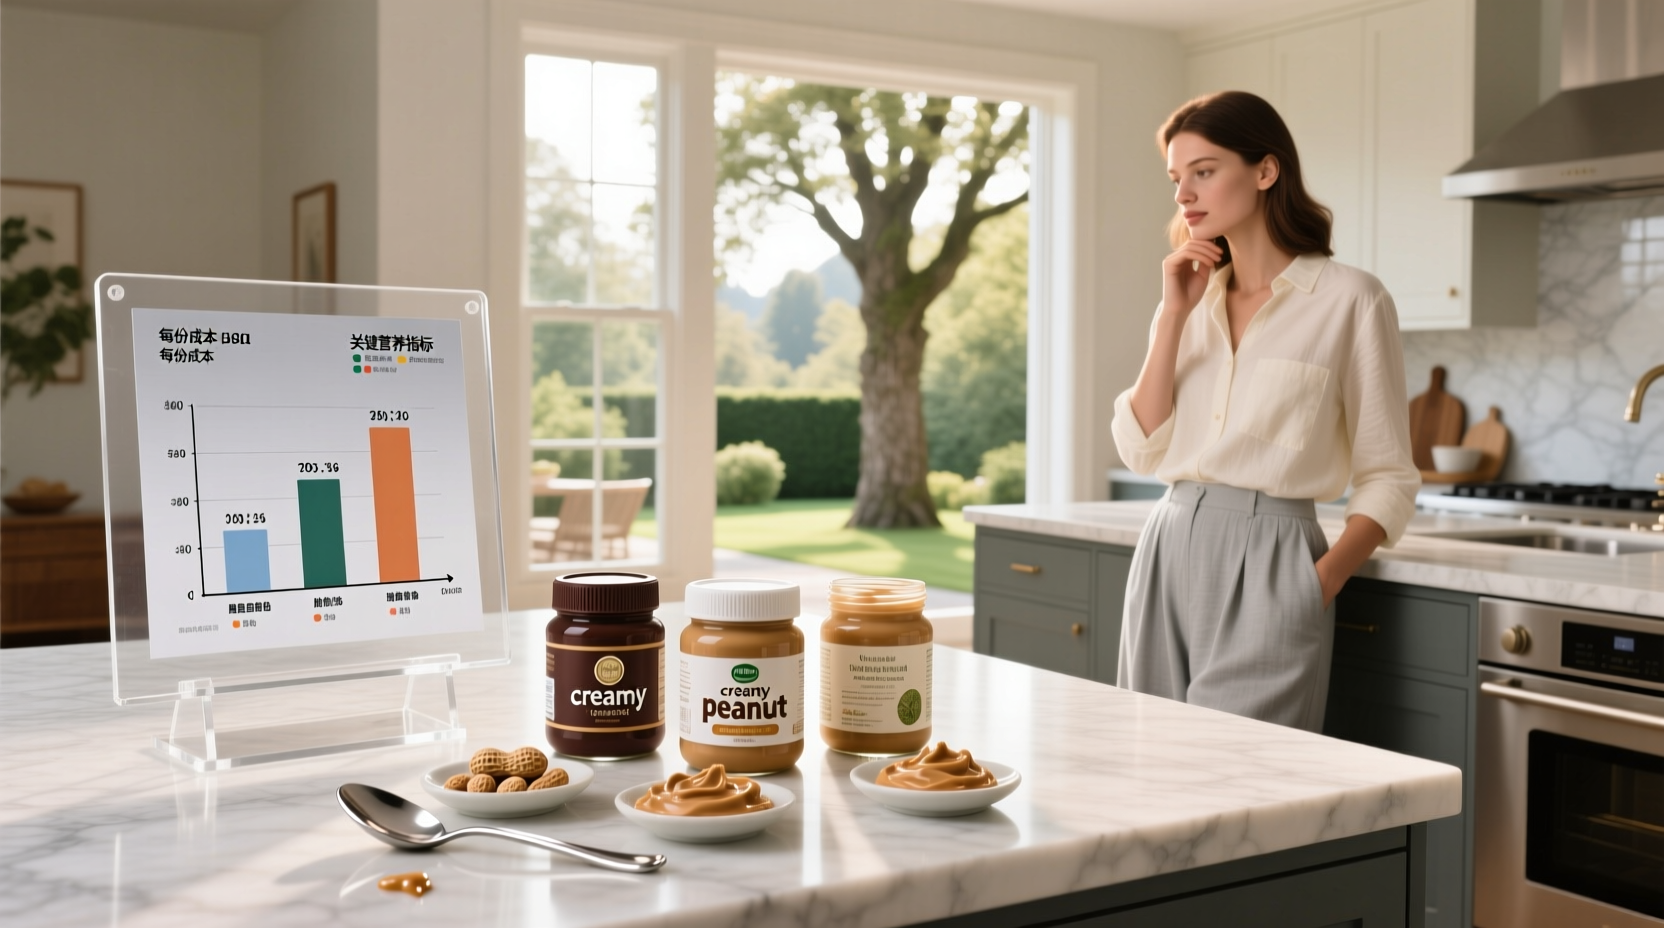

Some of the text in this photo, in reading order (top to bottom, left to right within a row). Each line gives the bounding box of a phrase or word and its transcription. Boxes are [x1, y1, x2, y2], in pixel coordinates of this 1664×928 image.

[159, 327, 218, 344] 每份成本
[350, 333, 434, 353] 关键营养指标
[159, 347, 215, 364] 每份成本
[570, 687, 648, 712] creamy
[702, 694, 788, 723] peanut
